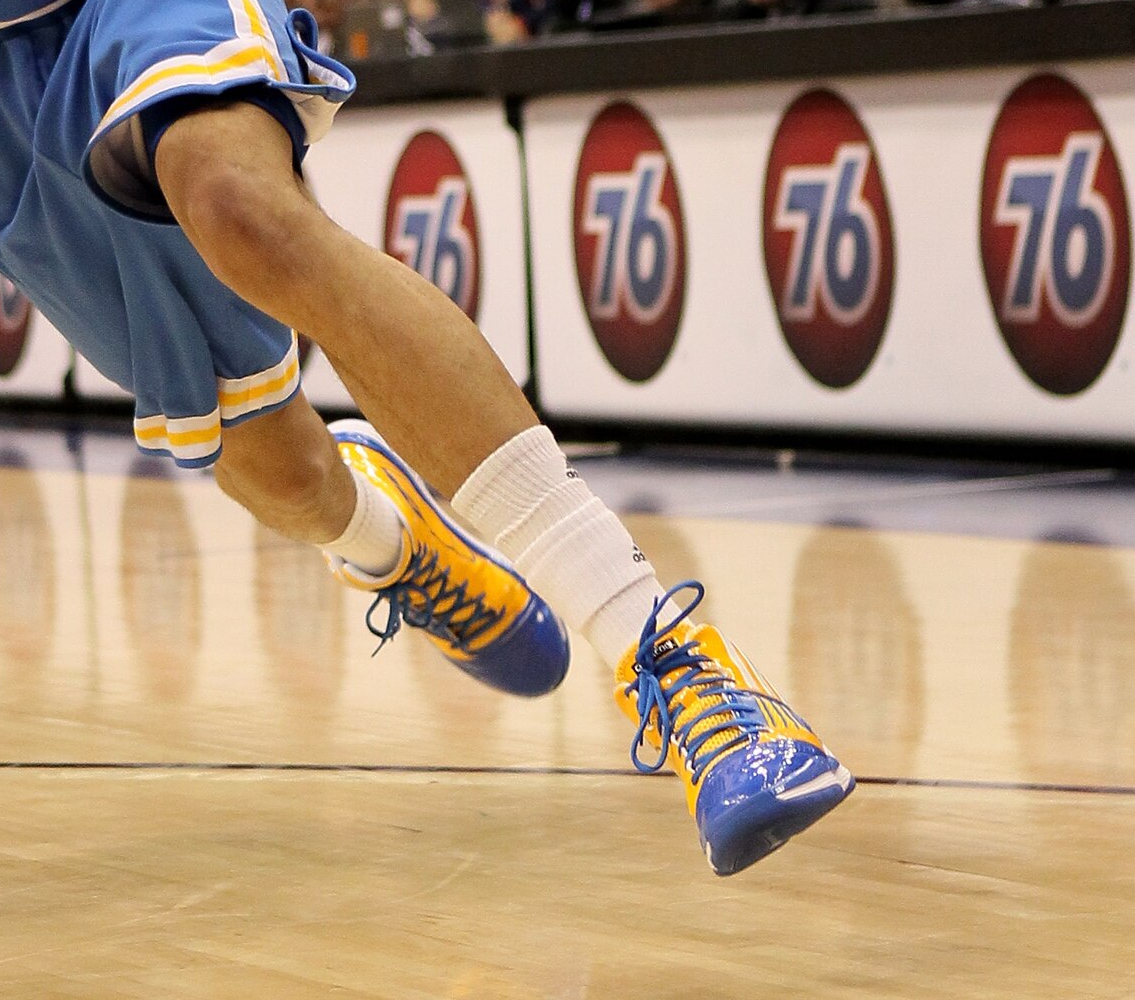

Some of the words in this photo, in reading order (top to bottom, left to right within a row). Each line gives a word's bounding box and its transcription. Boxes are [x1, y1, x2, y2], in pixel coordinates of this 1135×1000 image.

[392, 175, 475, 316] 76
[583, 152, 678, 323] 76
[775, 143, 880, 326] 76
[995, 131, 1116, 328] 76
